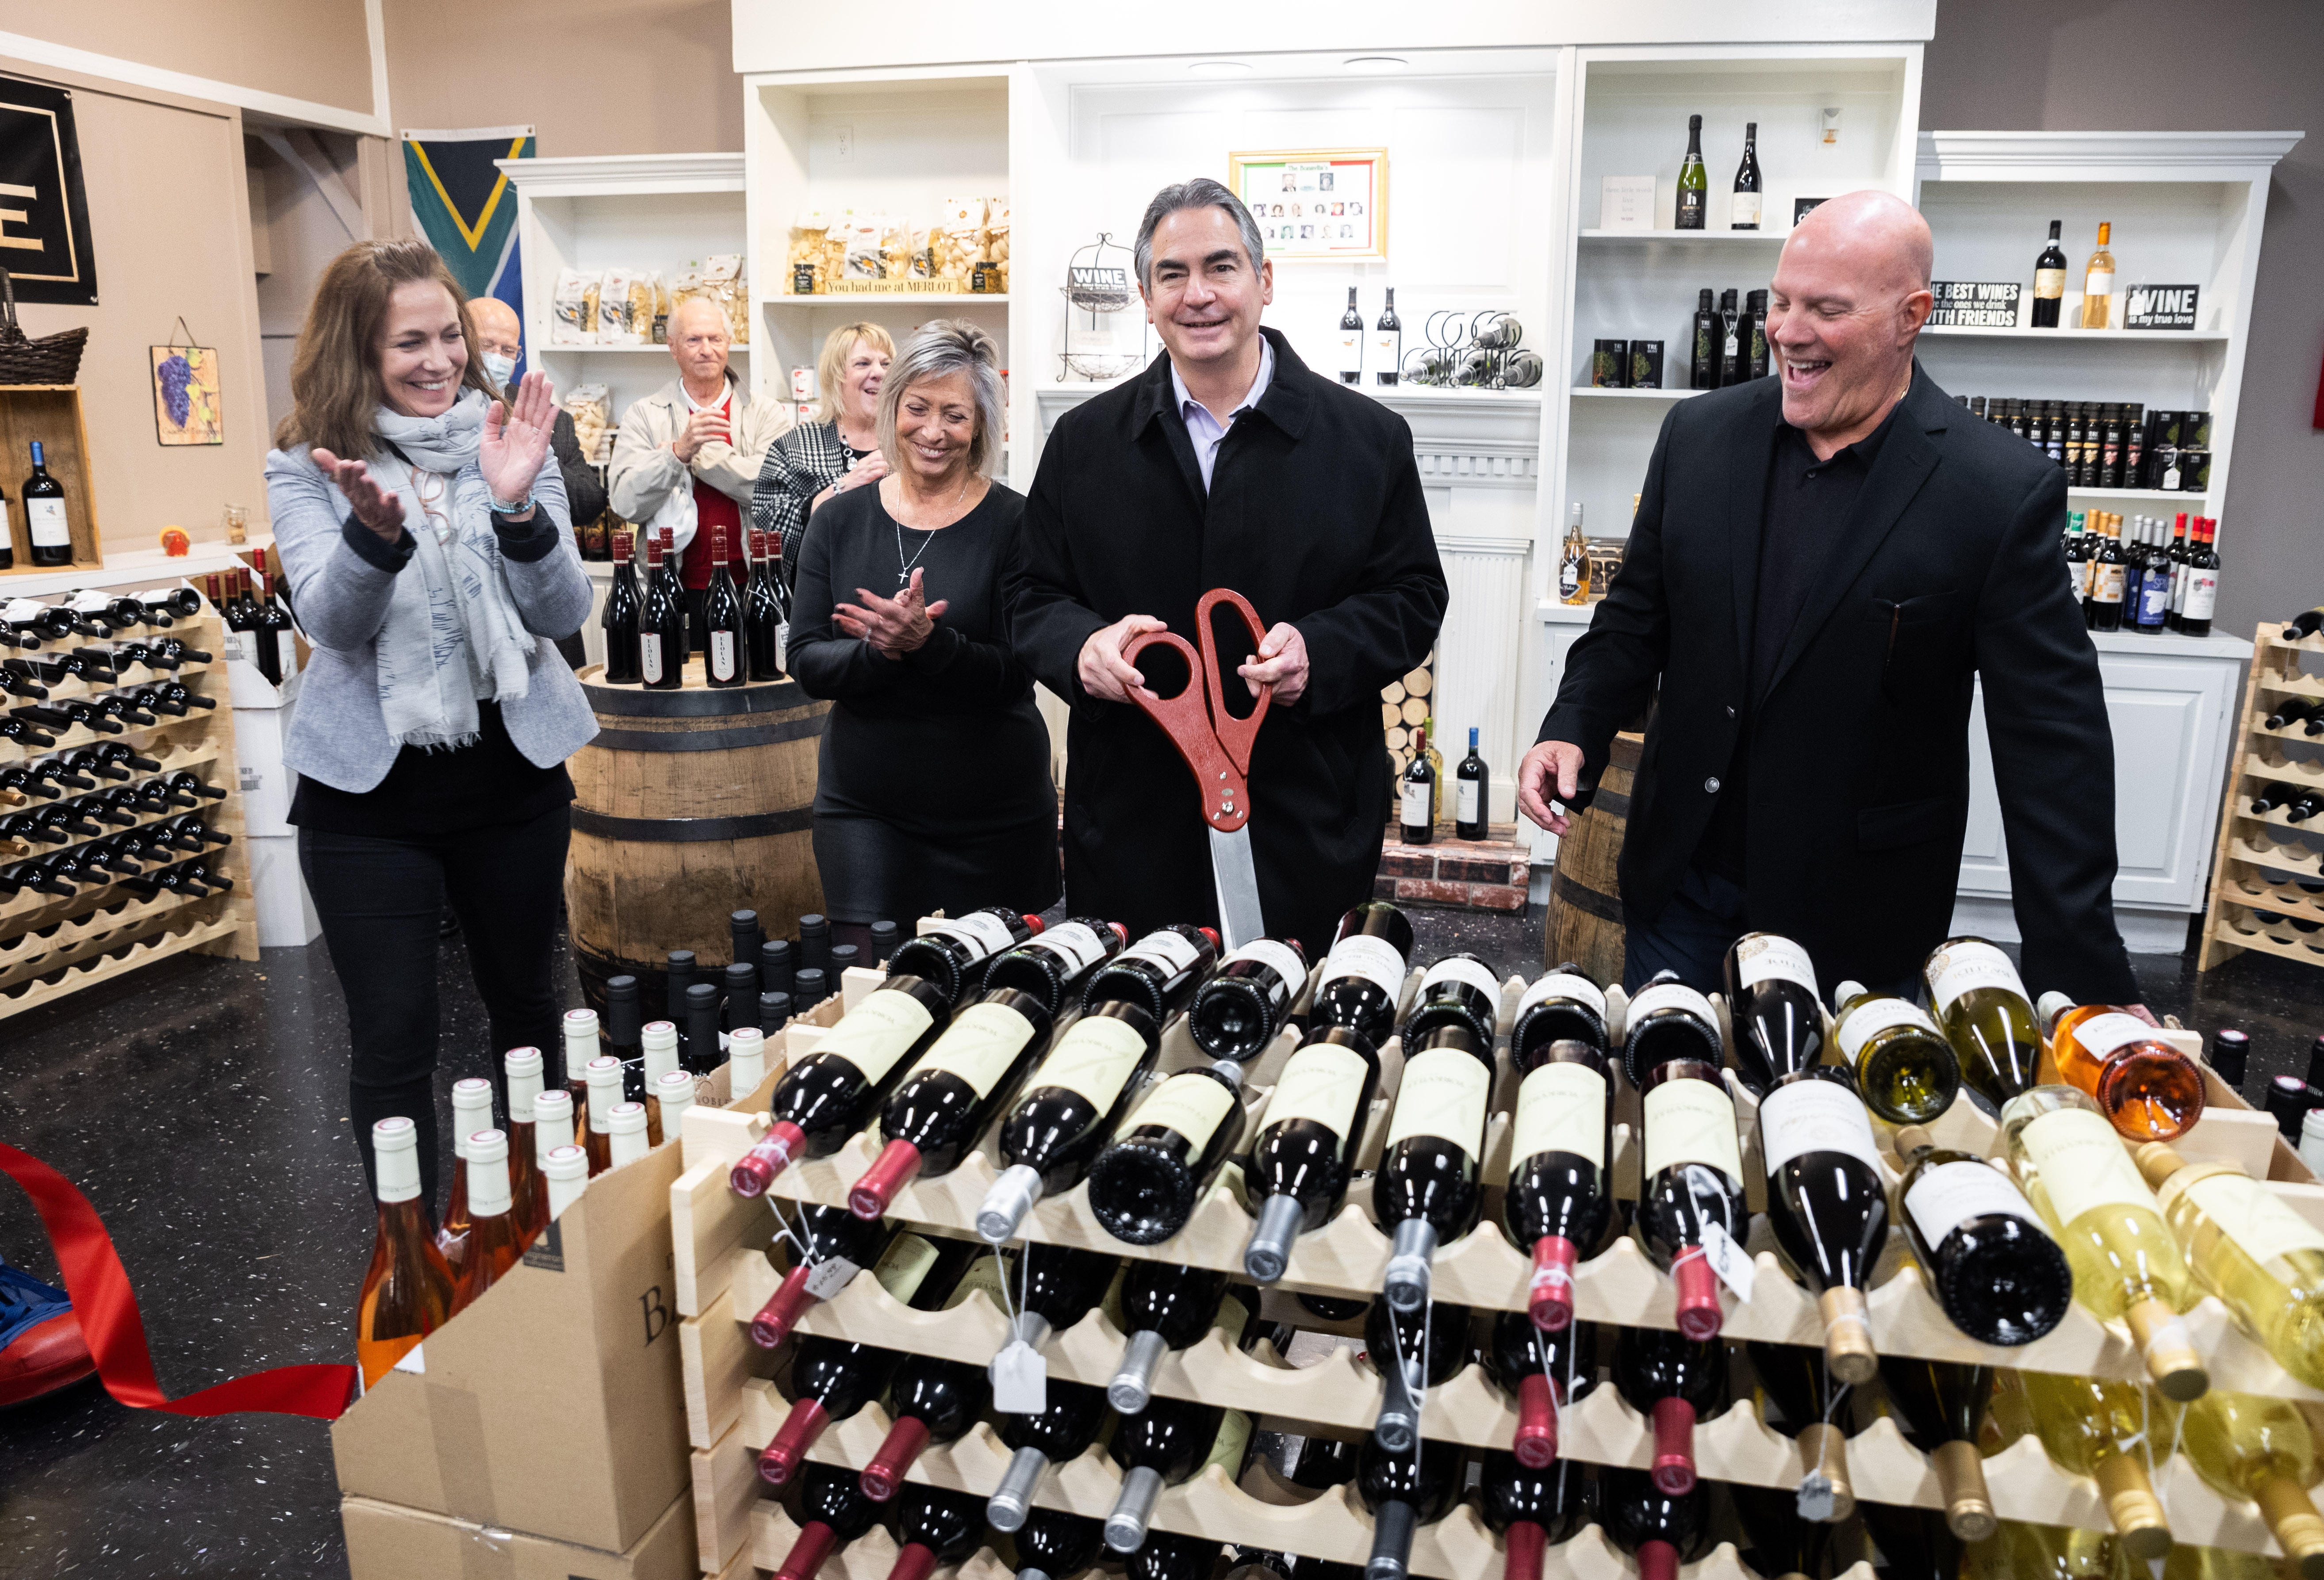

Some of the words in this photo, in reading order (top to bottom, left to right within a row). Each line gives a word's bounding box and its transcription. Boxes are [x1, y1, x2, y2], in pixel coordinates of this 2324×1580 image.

[1687, 192, 1697, 205] h
[1072, 268, 1125, 284] WINE
[828, 281, 848, 293] You
[851, 281, 872, 292] had
[875, 283, 891, 292] me
[894, 283, 904, 292] at
[907, 281, 954, 292] MERLOT
[1944, 283, 1976, 299] BEST
[1977, 283, 2018, 300] WINES
[1941, 299, 1953, 308] the
[1986, 299, 2007, 310] drink
[1957, 310, 2015, 326] FRIENDS
[2128, 315, 2137, 324] is
[2138, 315, 2153, 326] my
[2154, 314, 2173, 324] true
[2173, 313, 2194, 324] love
